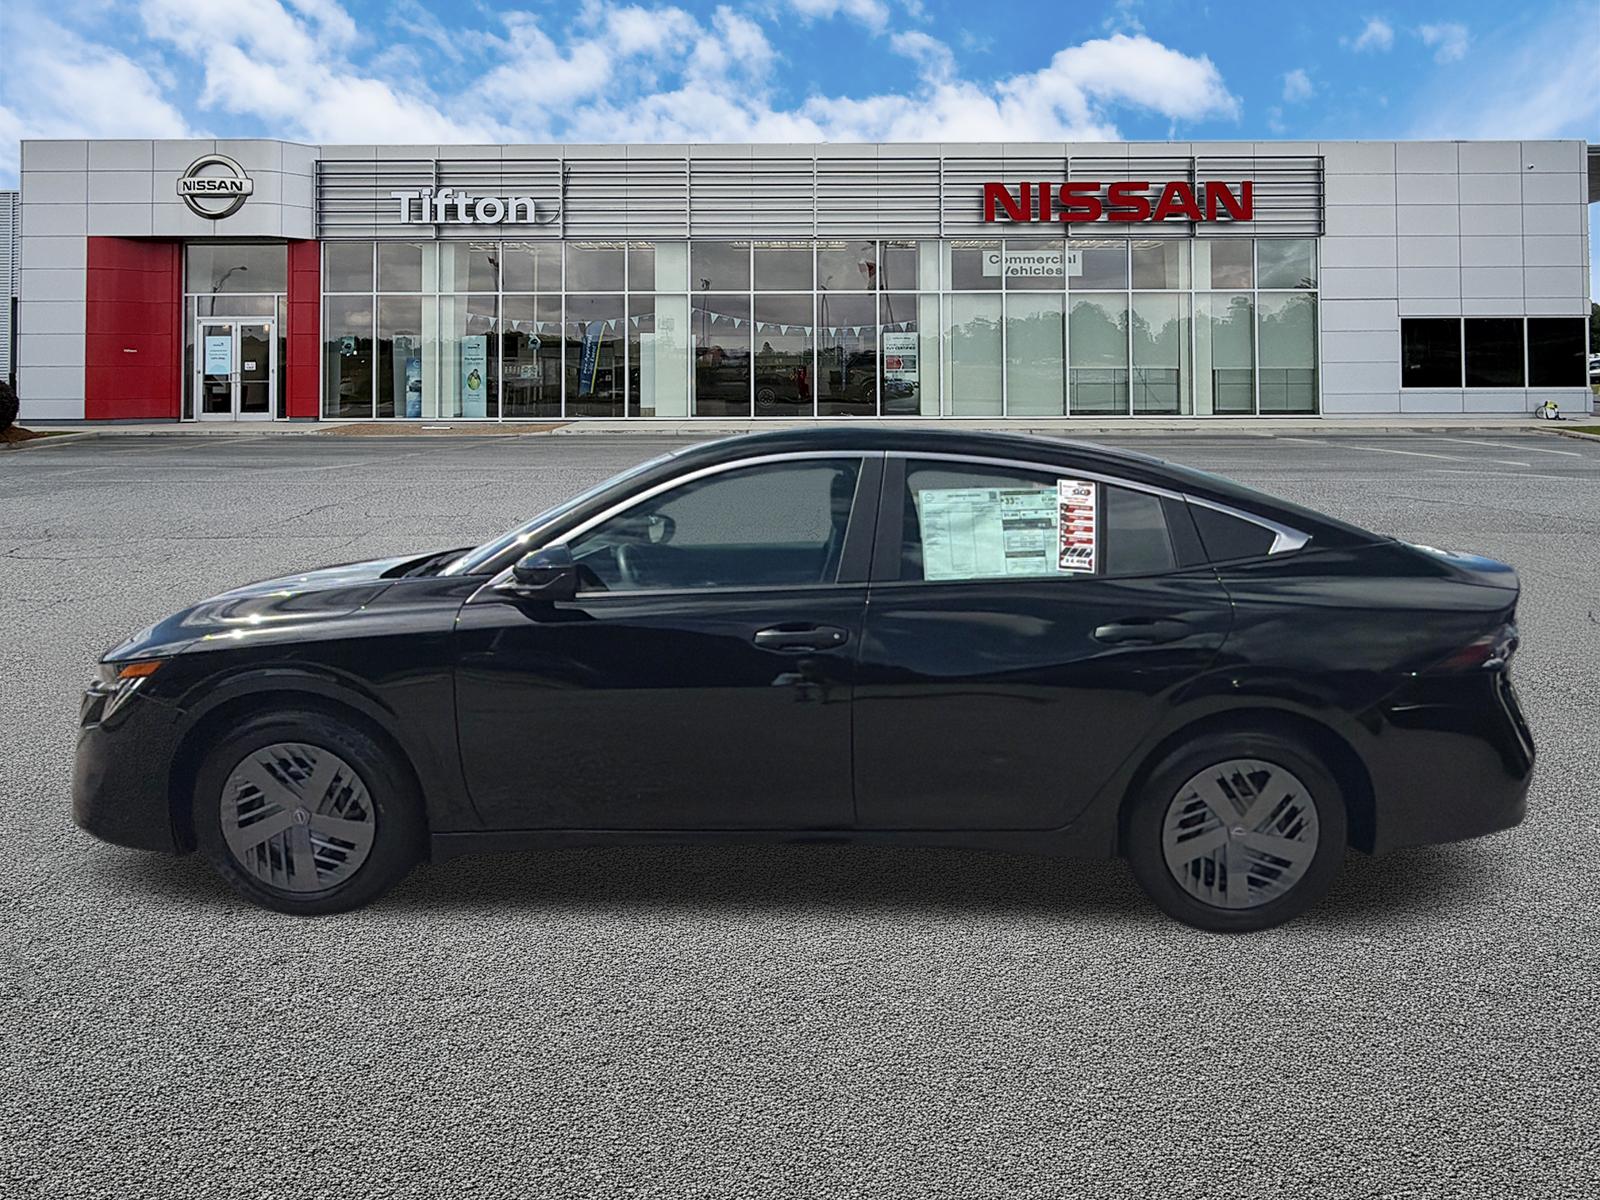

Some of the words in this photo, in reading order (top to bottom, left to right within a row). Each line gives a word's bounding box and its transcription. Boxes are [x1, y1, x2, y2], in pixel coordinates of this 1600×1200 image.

[183, 180, 243, 191] NISSAN
[983, 180, 1254, 223] NISSAN
[391, 188, 536, 224] Tifton
